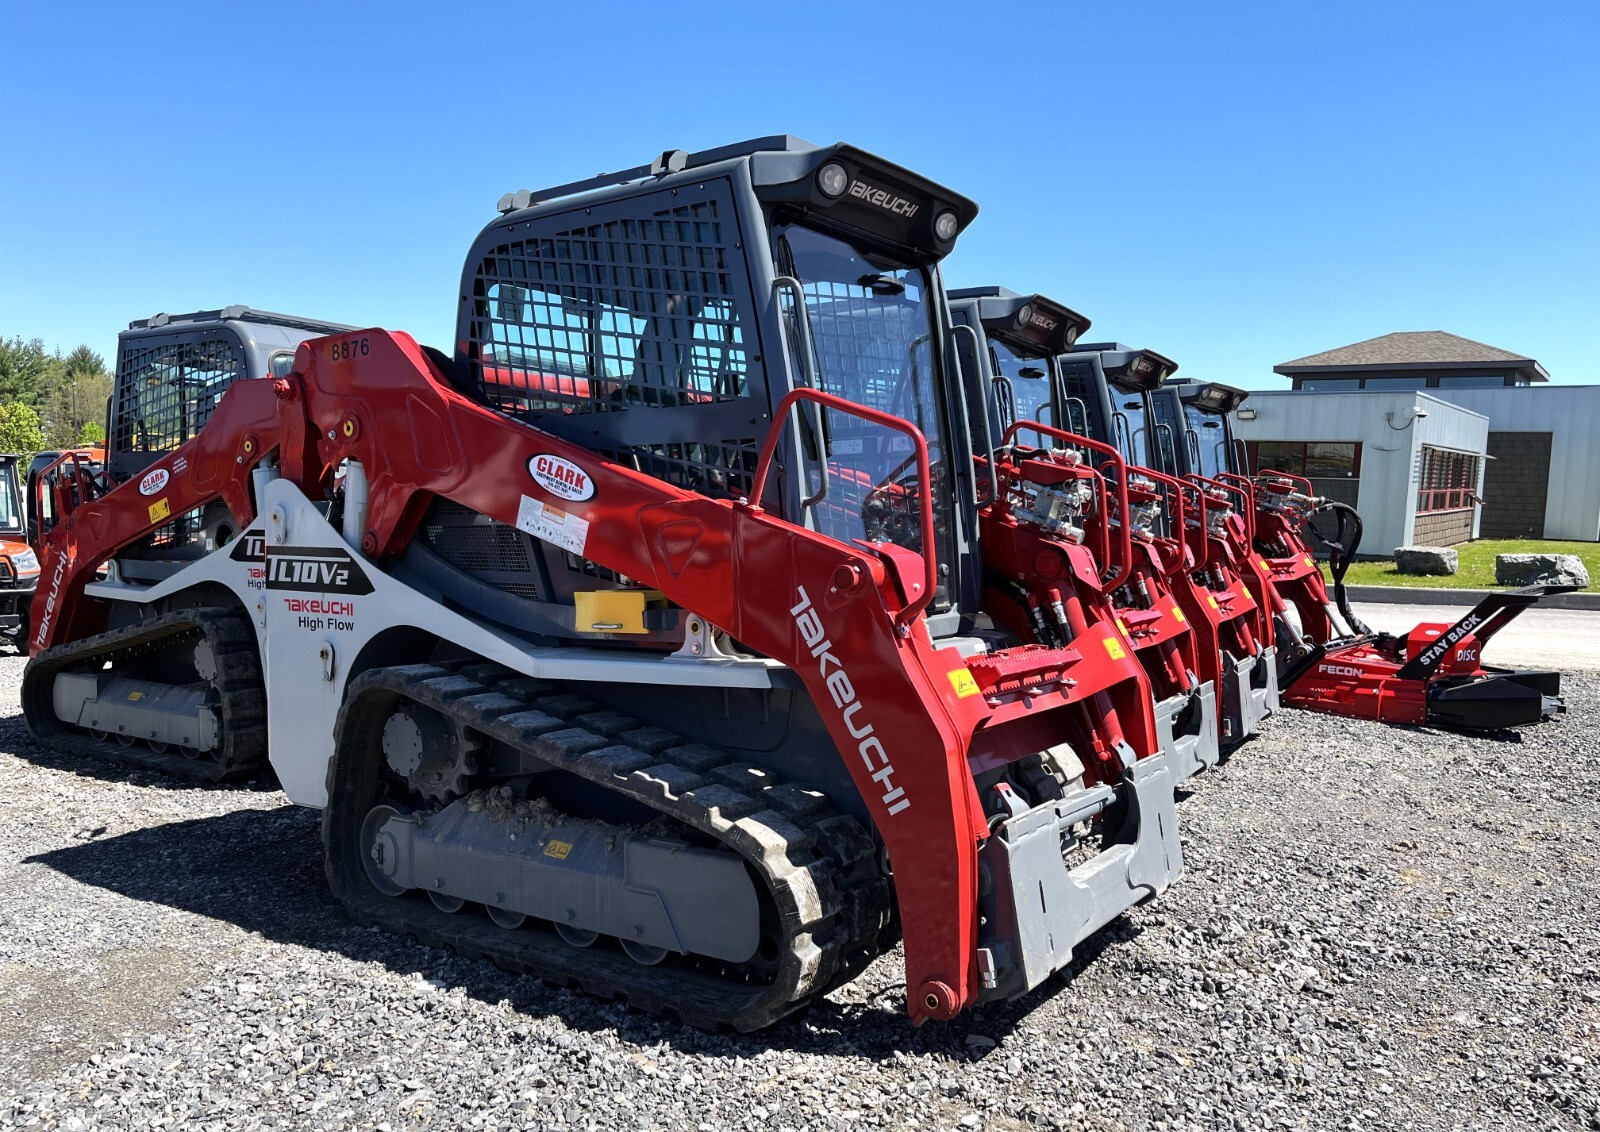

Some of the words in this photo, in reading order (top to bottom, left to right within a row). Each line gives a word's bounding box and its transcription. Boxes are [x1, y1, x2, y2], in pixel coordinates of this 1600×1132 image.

[332, 338, 370, 361] 8876
[142, 471, 165, 489] CLARK
[537, 457, 587, 490] CLARK
[37, 551, 68, 645] TAKEUCHI
[284, 599, 354, 616] TAKEUCHI
[298, 616, 324, 631] High
[327, 618, 354, 631] Flow
[1420, 640, 1449, 666] STAY
[1449, 613, 1482, 643] BACK
[1457, 649, 1476, 662] DISC
[1318, 665, 1363, 677] FECON
[790, 584, 911, 816] TAKEUCHI
